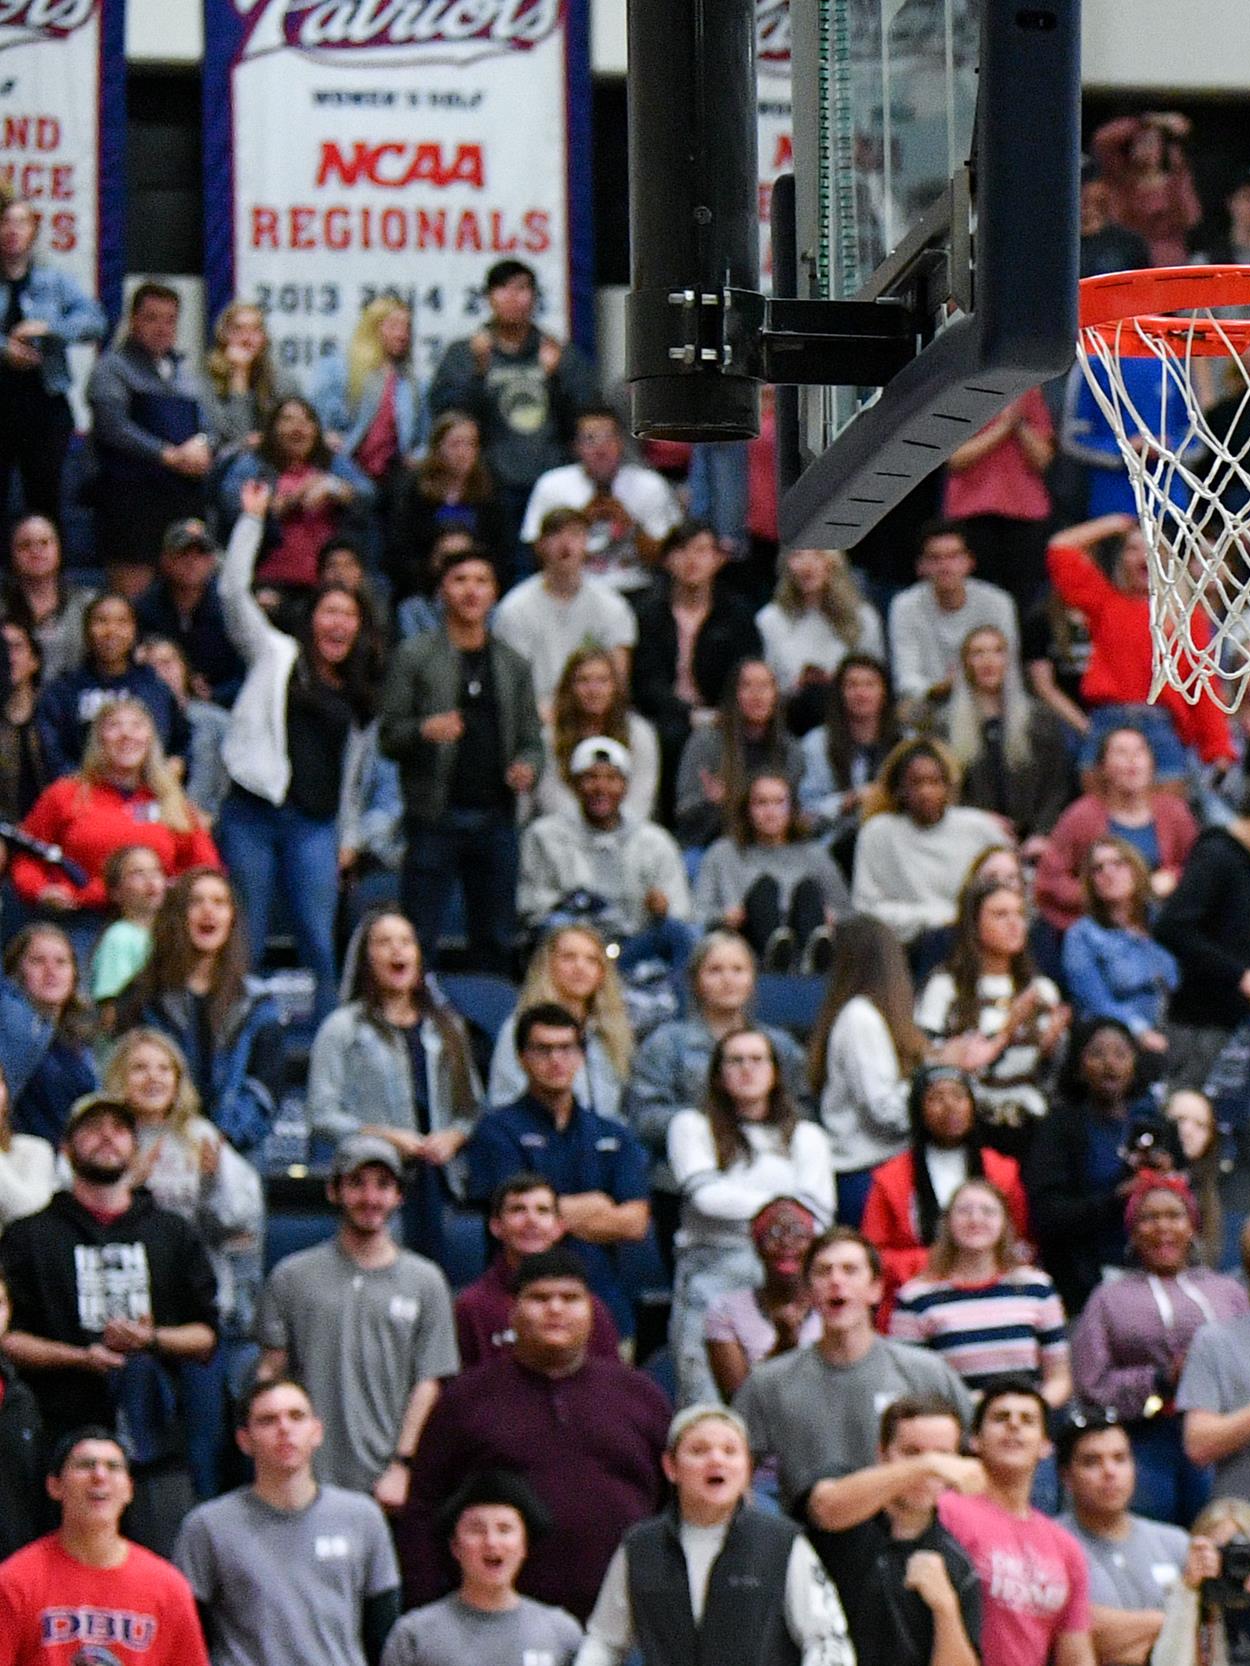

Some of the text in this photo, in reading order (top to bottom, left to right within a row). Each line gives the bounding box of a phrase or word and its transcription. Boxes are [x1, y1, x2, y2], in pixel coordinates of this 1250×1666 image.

[316, 143, 486, 189] NCAA
[249, 207, 552, 253] REGIONALS
[40, 1606, 158, 1652] DBU
